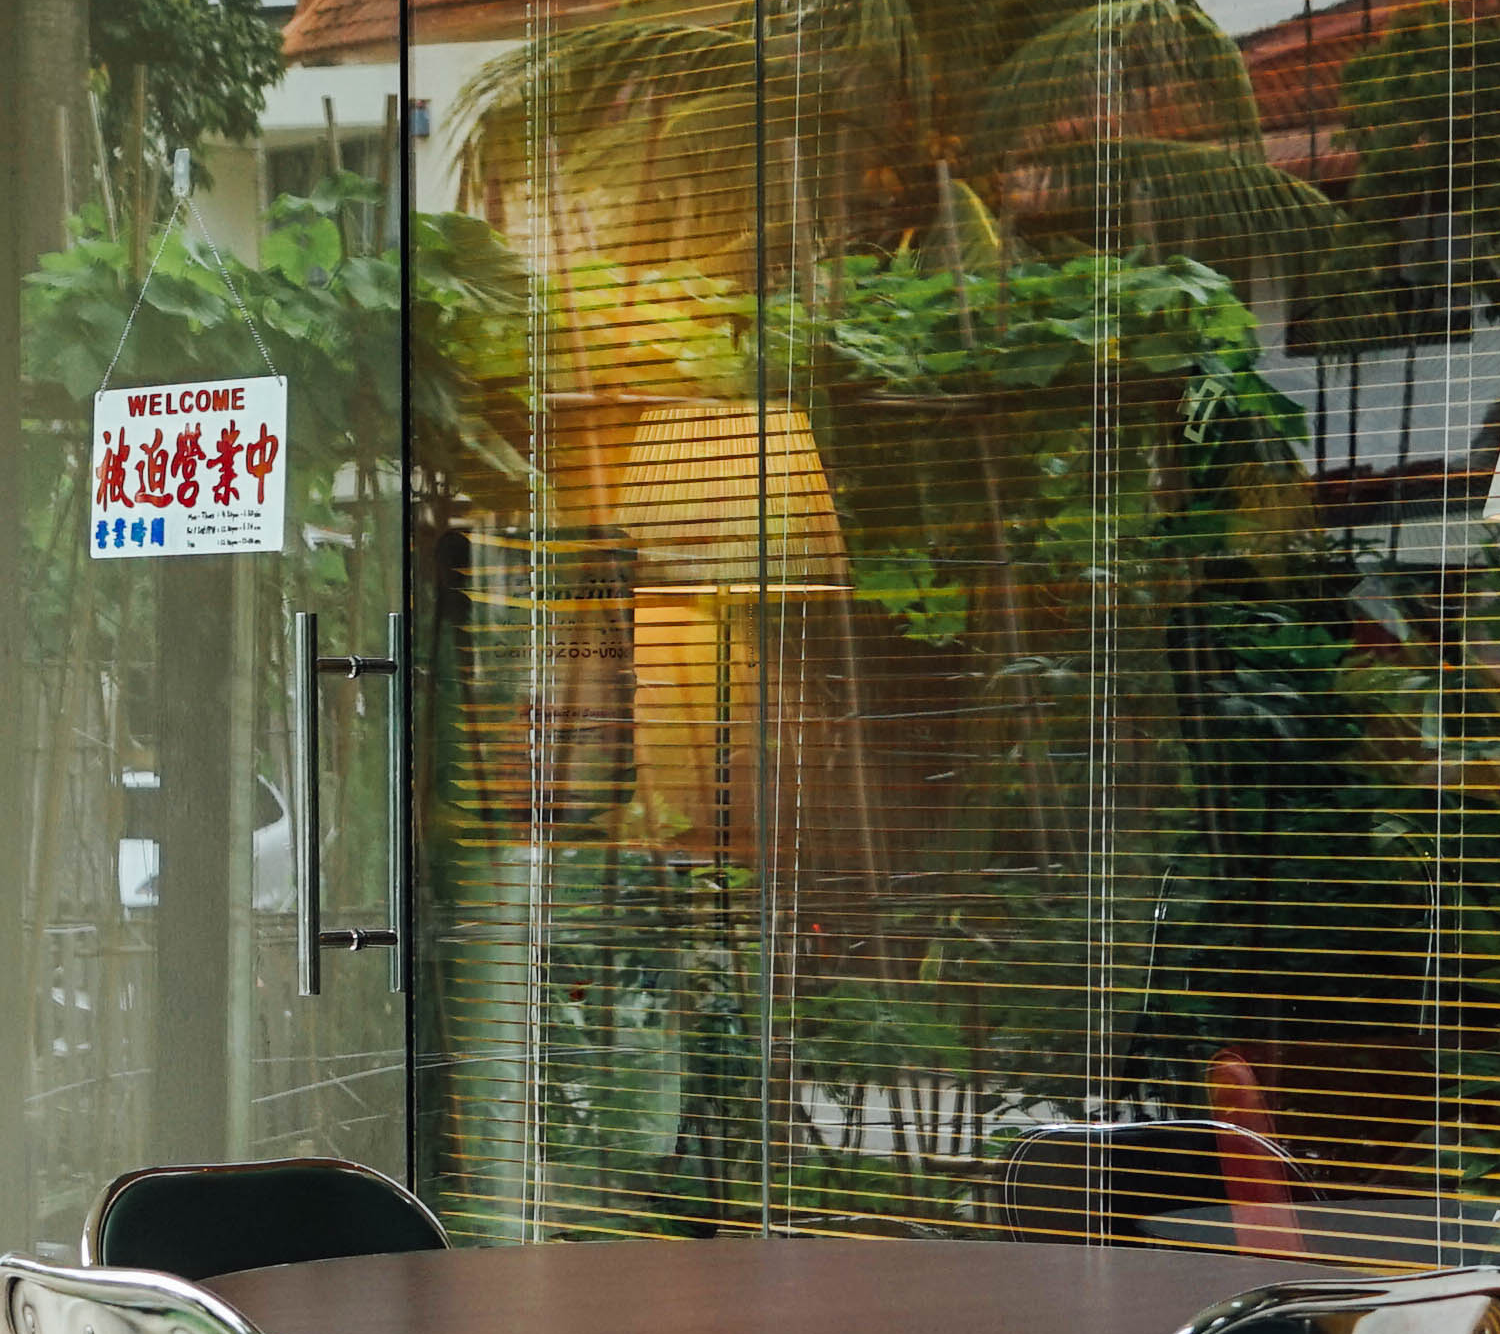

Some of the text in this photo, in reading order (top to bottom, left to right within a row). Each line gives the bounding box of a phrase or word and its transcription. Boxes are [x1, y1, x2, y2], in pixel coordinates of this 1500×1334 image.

[128, 388, 245, 417] WELCOME
[96, 419, 279, 512] 被迫營業中
